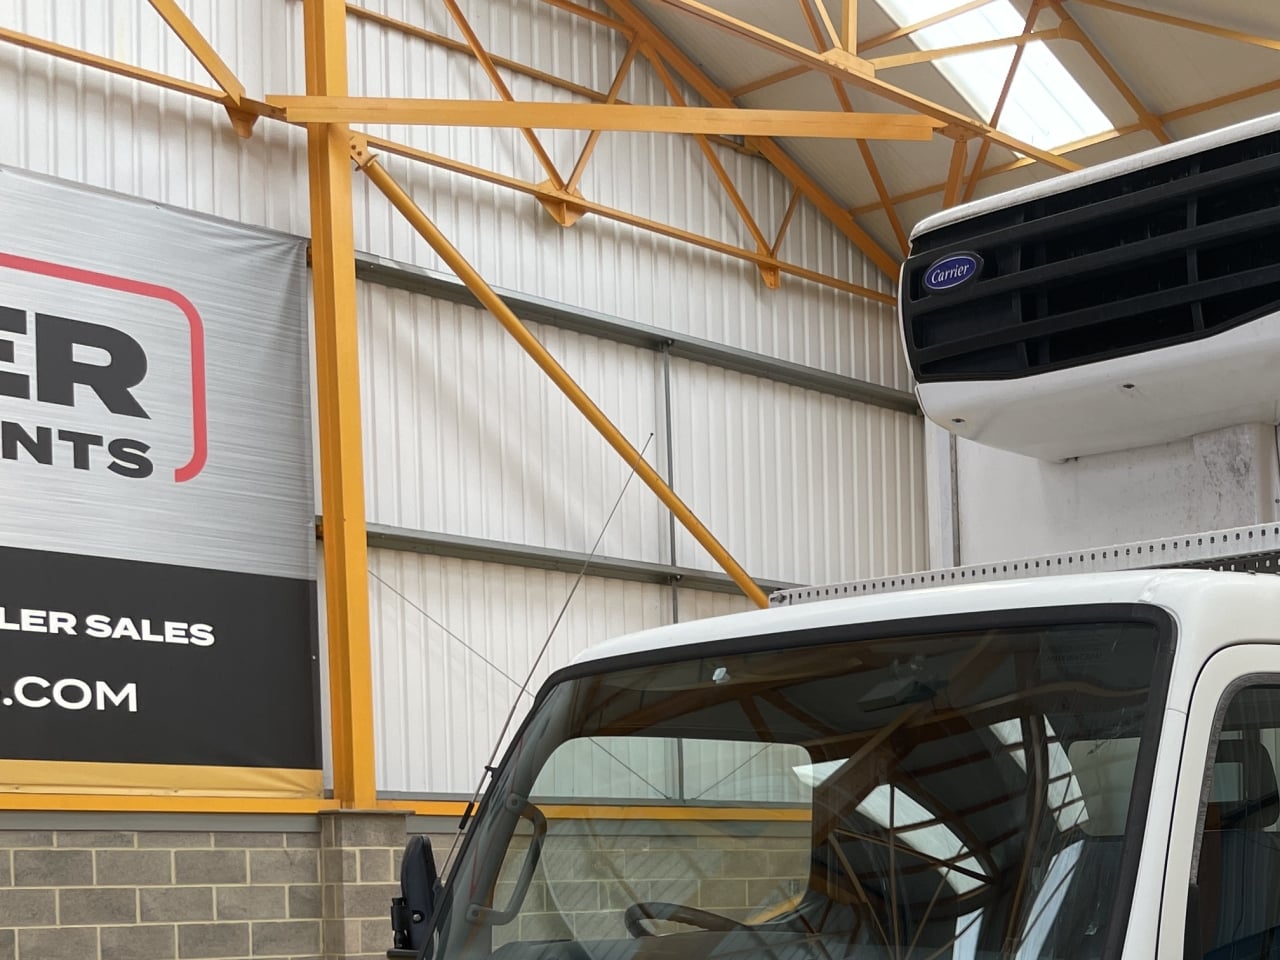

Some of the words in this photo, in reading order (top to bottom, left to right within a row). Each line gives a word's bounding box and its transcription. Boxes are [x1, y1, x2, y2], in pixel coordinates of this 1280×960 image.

[931, 264, 970, 284] Carrier
[1, 420, 154, 479] NTS
[0, 606, 78, 635] LER
[85, 614, 215, 646] SALES
[2, 676, 138, 712] .COM
